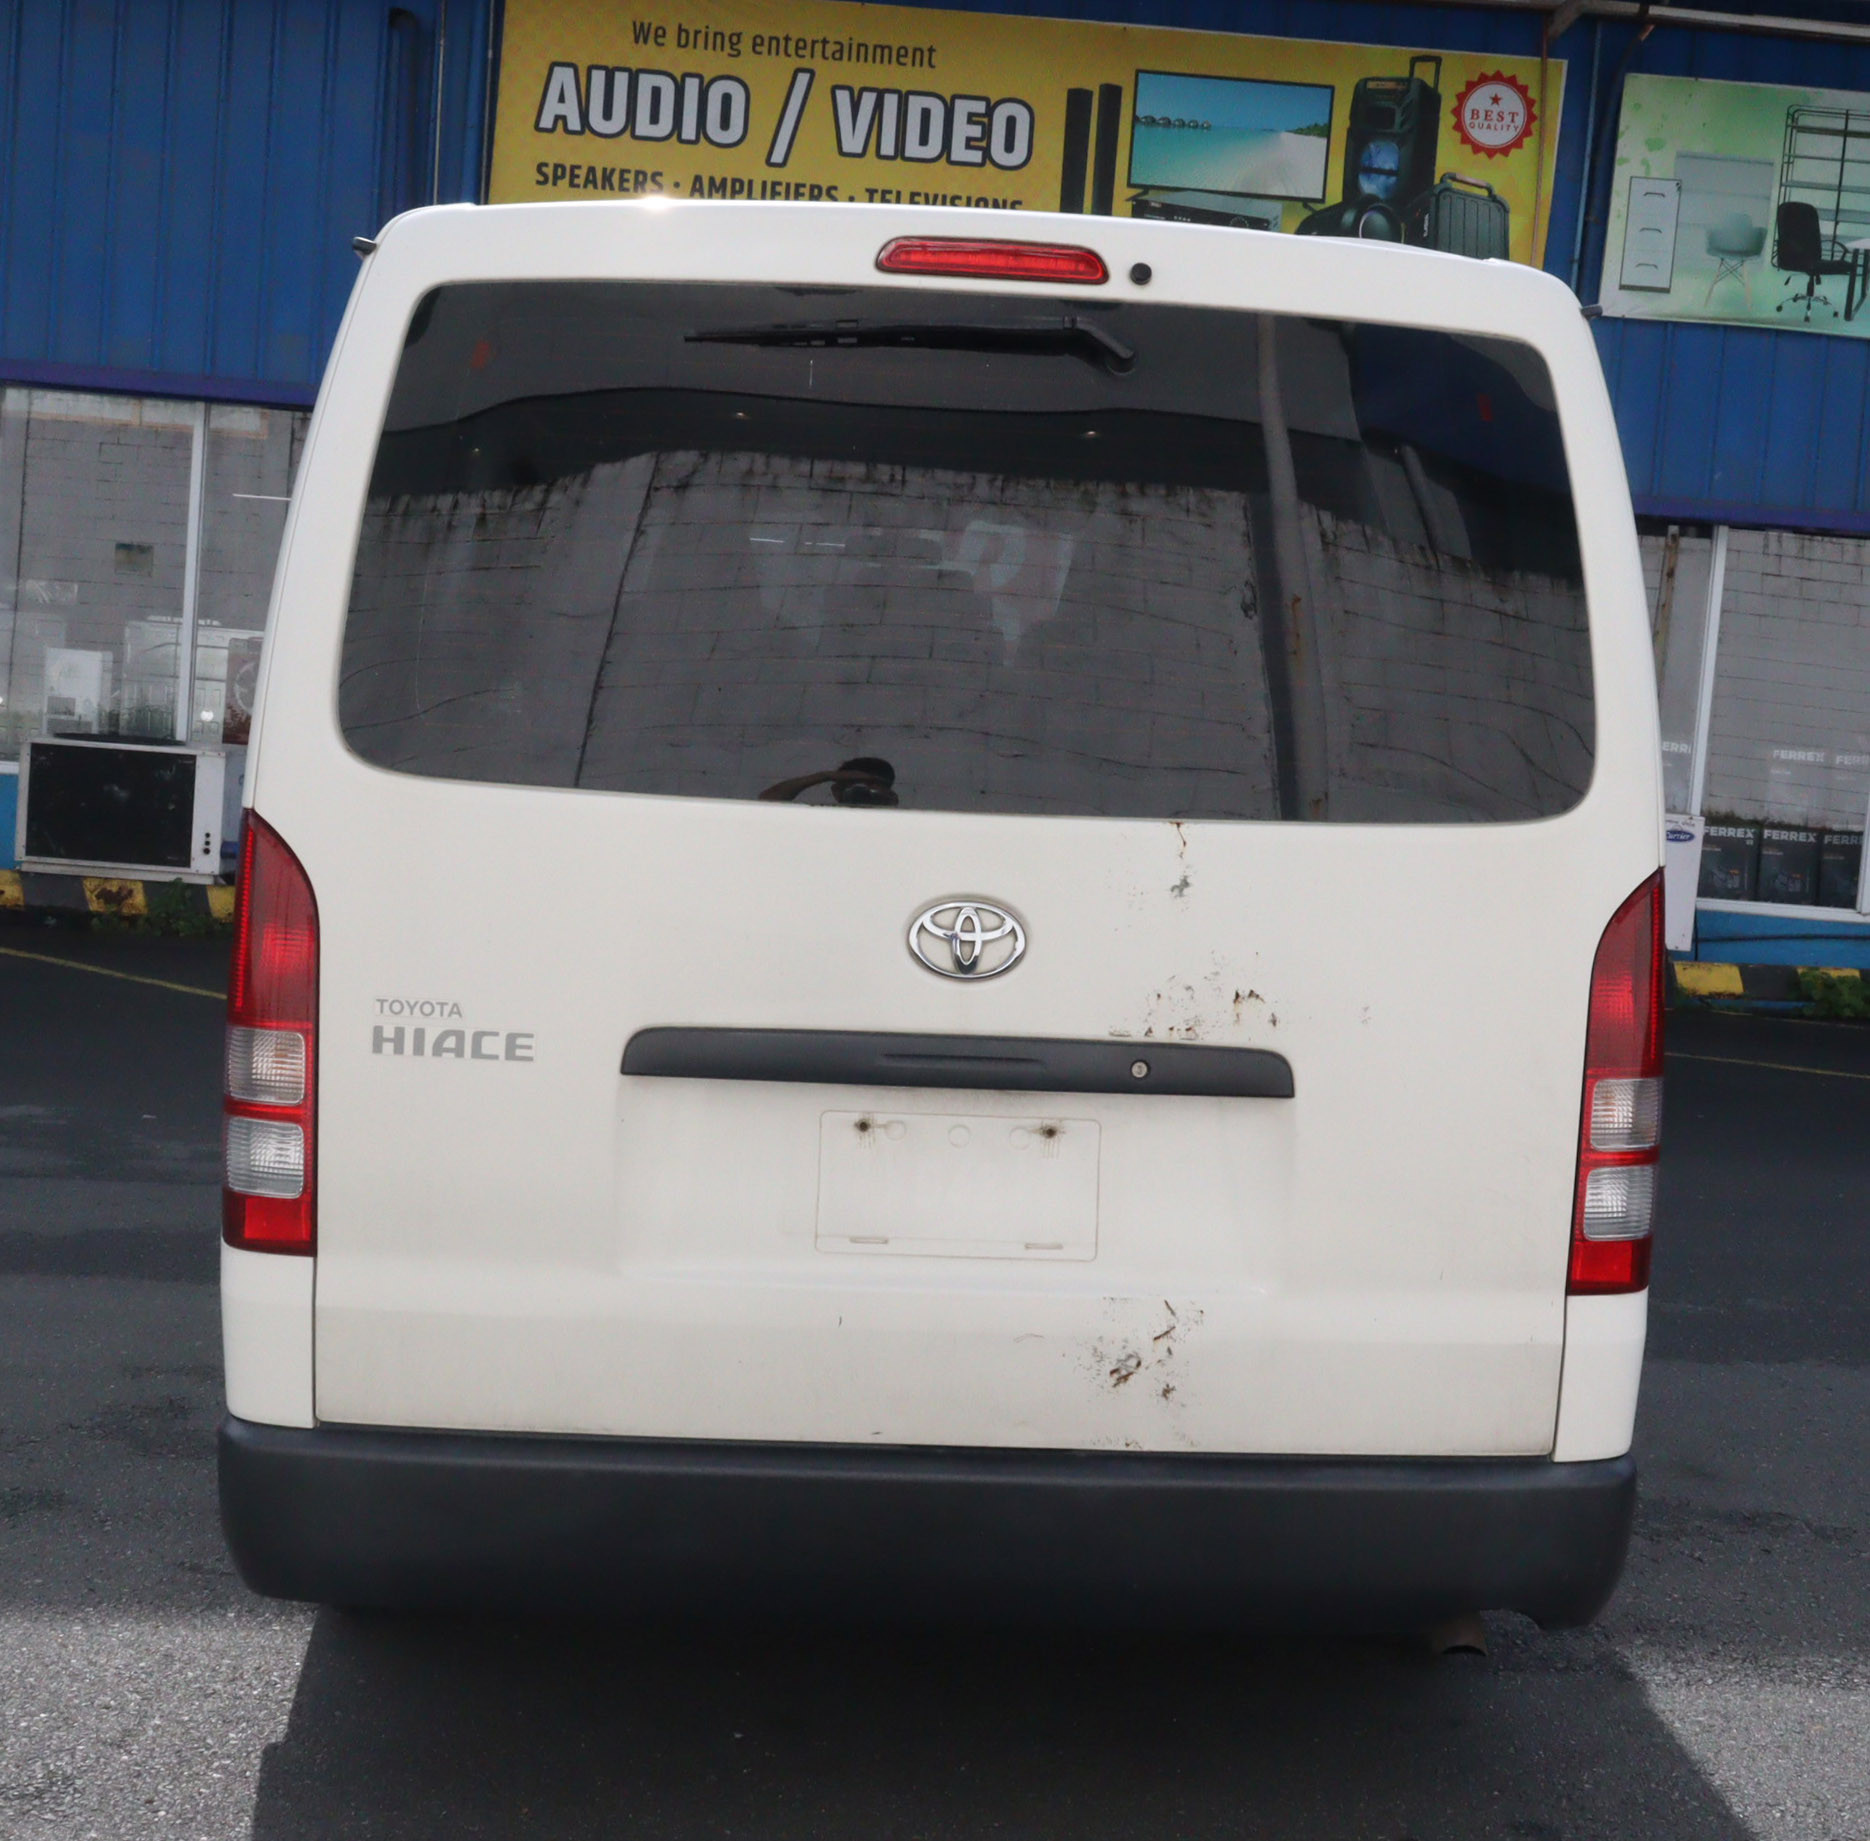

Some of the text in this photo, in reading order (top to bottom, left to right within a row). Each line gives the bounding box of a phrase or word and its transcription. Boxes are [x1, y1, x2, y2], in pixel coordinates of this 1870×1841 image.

[632, 20, 937, 69] We bring entertainment
[534, 61, 1035, 170] AUDIO / VIDEO
[1470, 109, 1519, 123] BEST
[1469, 122, 1520, 132] QUALITY
[536, 162, 665, 194] SPEAKERS
[690, 174, 839, 202] AMPLIFIERS
[1763, 829, 1817, 843] FERREX
[1824, 835, 1864, 846] FERR
[376, 999, 463, 1018] TOYOTA
[372, 1025, 534, 1061] HIACE
